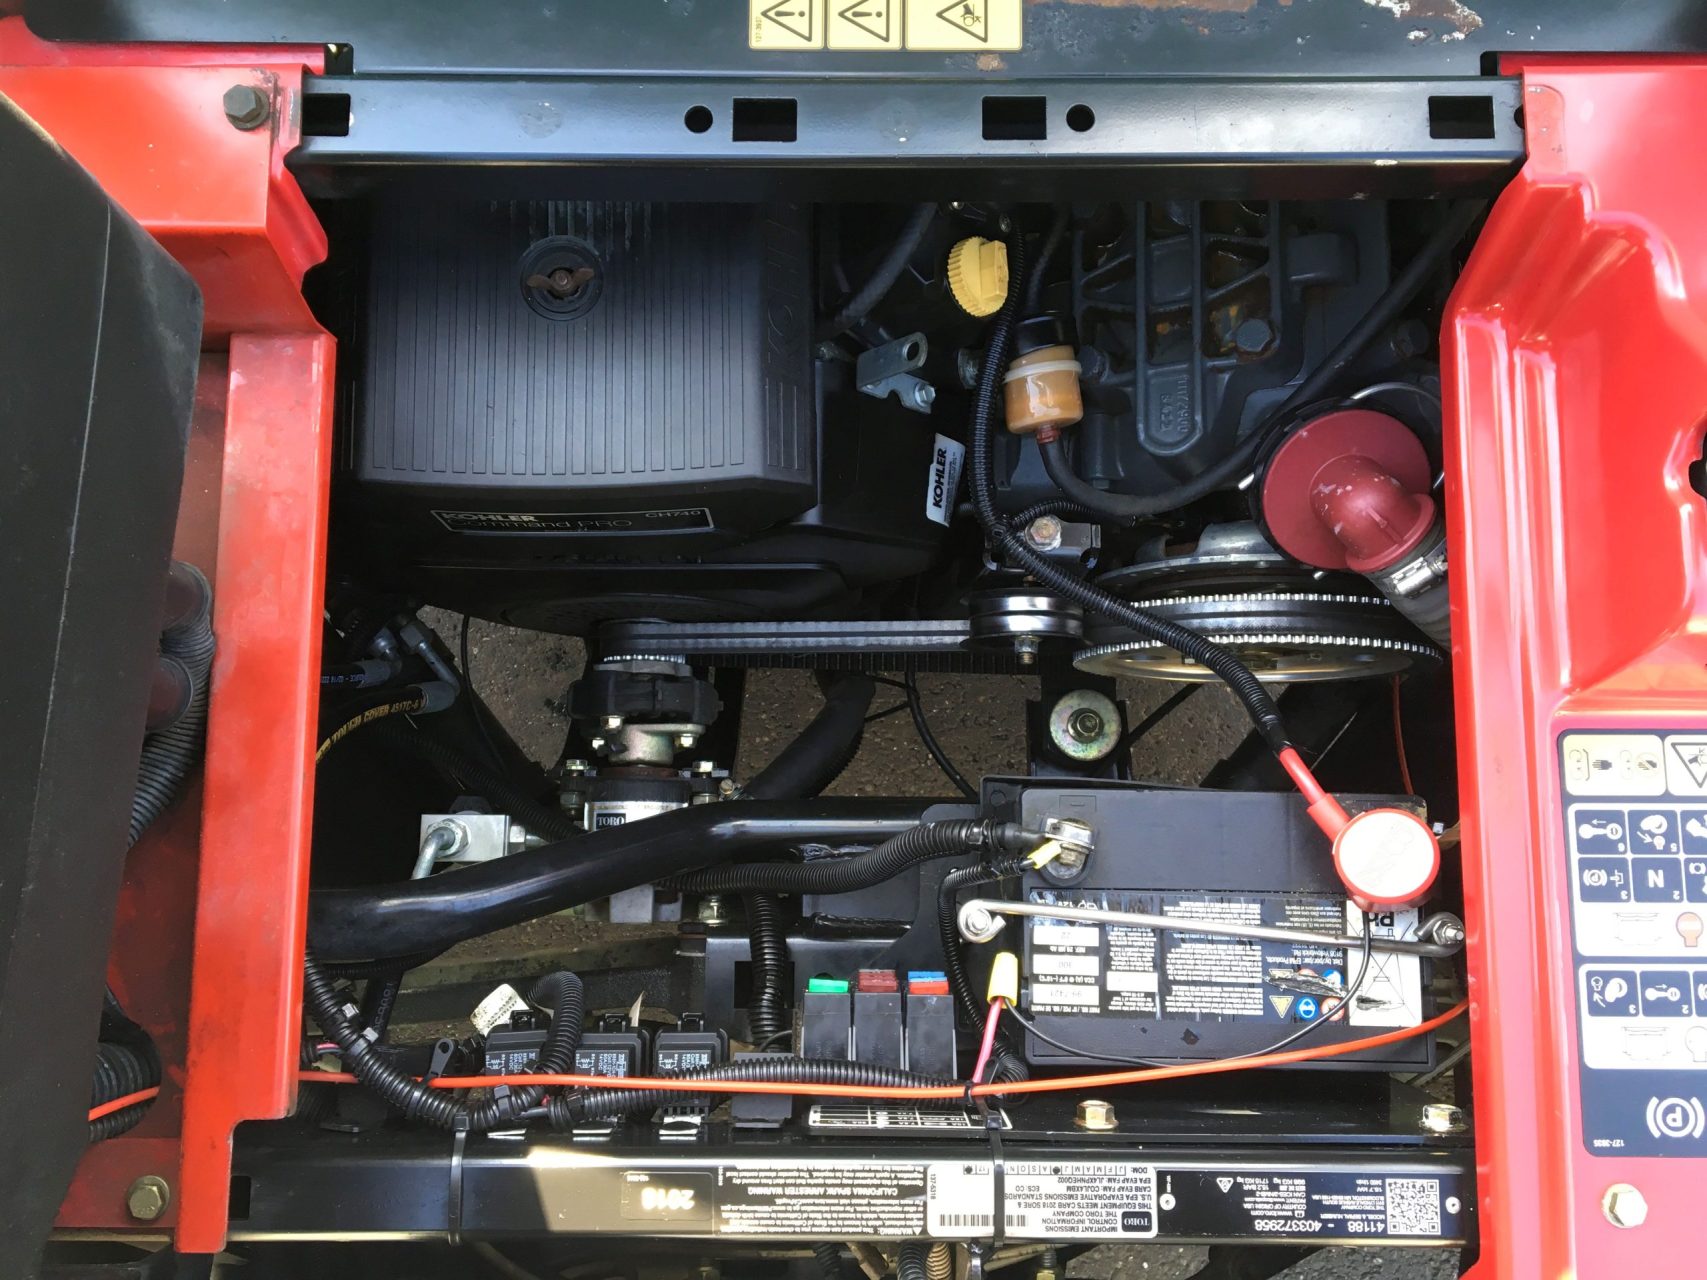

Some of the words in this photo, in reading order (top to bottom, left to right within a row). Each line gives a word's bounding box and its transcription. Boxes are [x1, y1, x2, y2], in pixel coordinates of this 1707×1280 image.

[932, 448, 947, 509] KOHLER
[441, 512, 537, 522] KOHLER
[363, 703, 390, 722] COVER
[598, 816, 625, 826] TORO
[1670, 843, 1677, 852] 5
[1648, 870, 1664, 887] N
[1621, 890, 1628, 899] 3
[1673, 890, 1680, 899] 2
[1681, 1005, 1689, 1013] 2
[1666, 1107, 1682, 1127] P
[748, 1187, 783, 1195] WARNING
[785, 1187, 824, 1195] ARRESTER
[641, 1187, 694, 1210] 2018
[1255, 1220, 1322, 1231] 403372958
[1348, 1222, 1385, 1232] 41188
